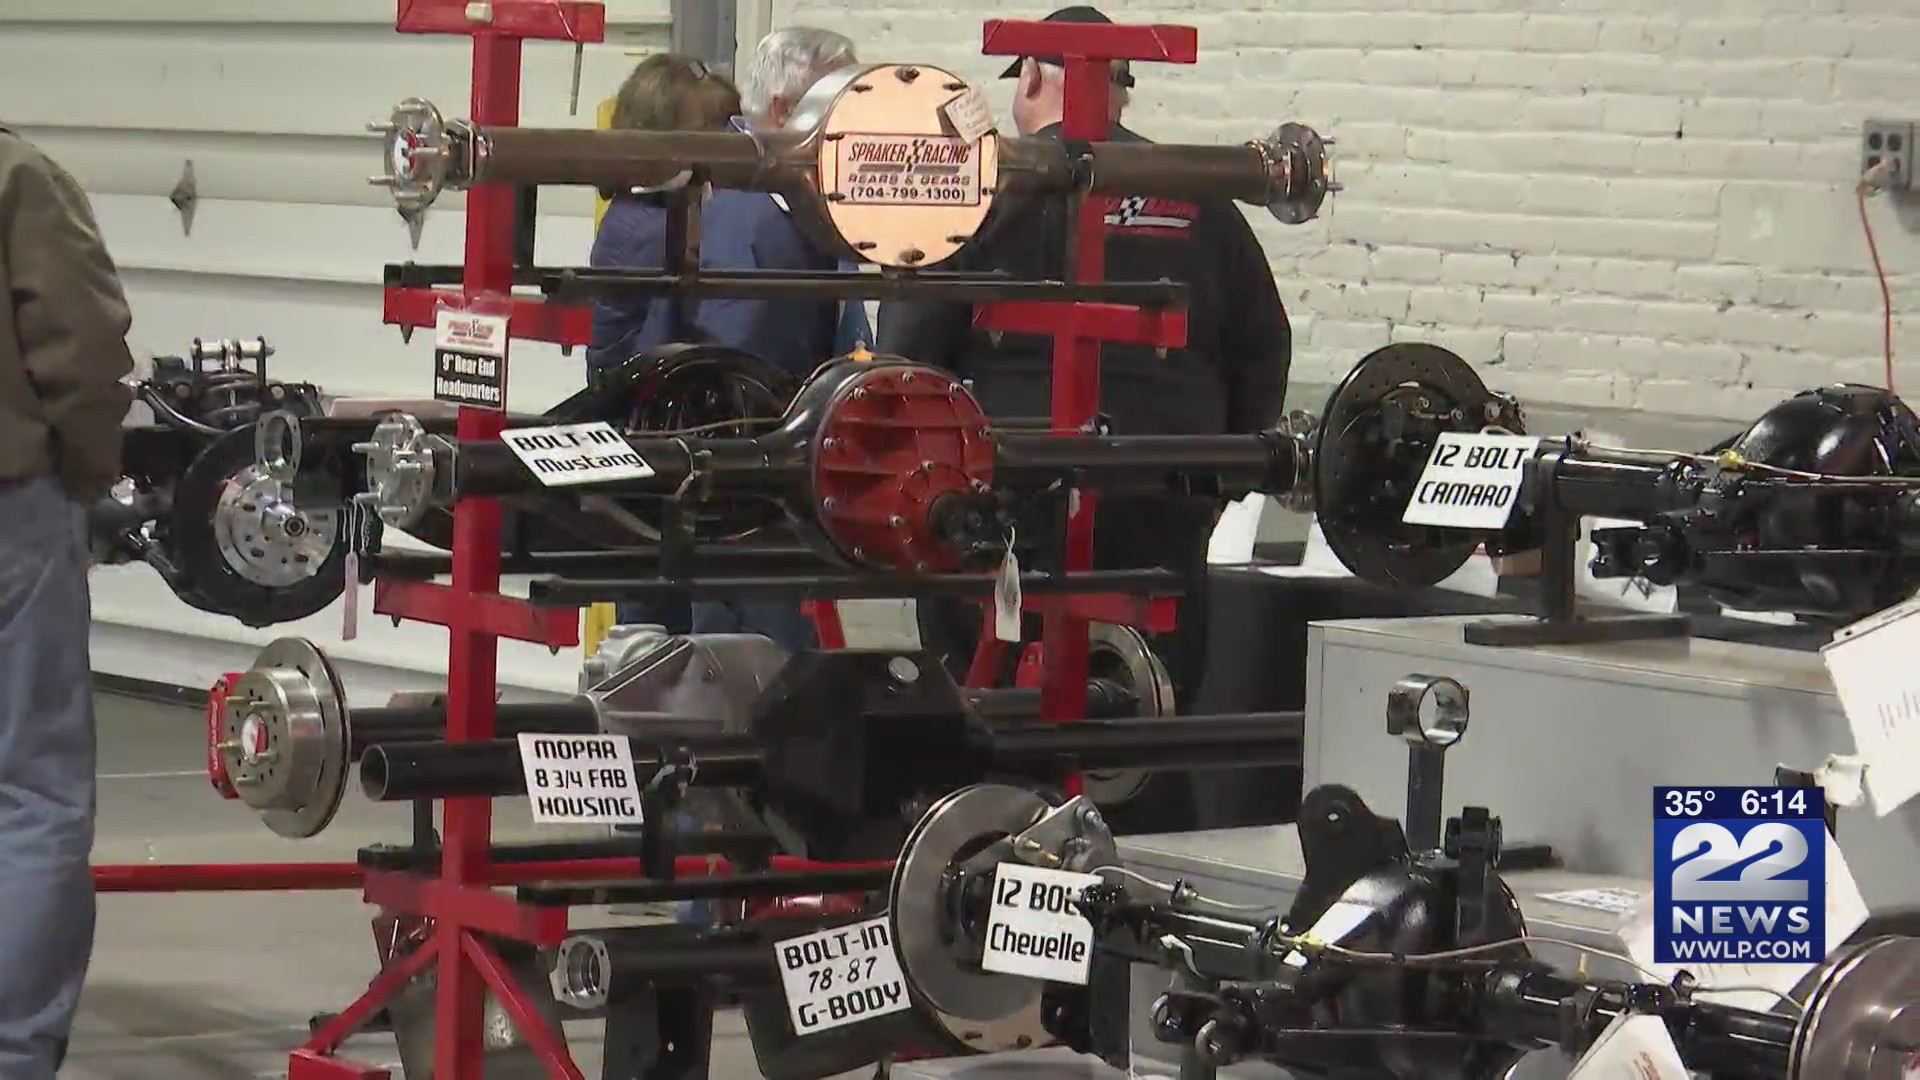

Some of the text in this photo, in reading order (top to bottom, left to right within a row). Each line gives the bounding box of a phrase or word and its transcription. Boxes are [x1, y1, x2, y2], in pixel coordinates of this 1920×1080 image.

[848, 142, 972, 164] SPRAKER RACING
[848, 173, 971, 186] REARS & GEARS
[851, 186, 966, 202] (704-799-1300)
[478, 357, 496, 377] End
[436, 376, 500, 402] Headquarters
[533, 453, 644, 473] Mustang
[1432, 444, 1529, 470] 12 BOLT
[1418, 481, 1512, 508] CAMARO
[534, 739, 618, 760] MOPAR
[535, 768, 628, 789] 8 3/4 FAB
[537, 797, 636, 817] HOUSING
[996, 877, 1084, 916] 12 BOL
[990, 922, 1086, 963] Chevelle
[798, 980, 902, 1028] G-BODY
